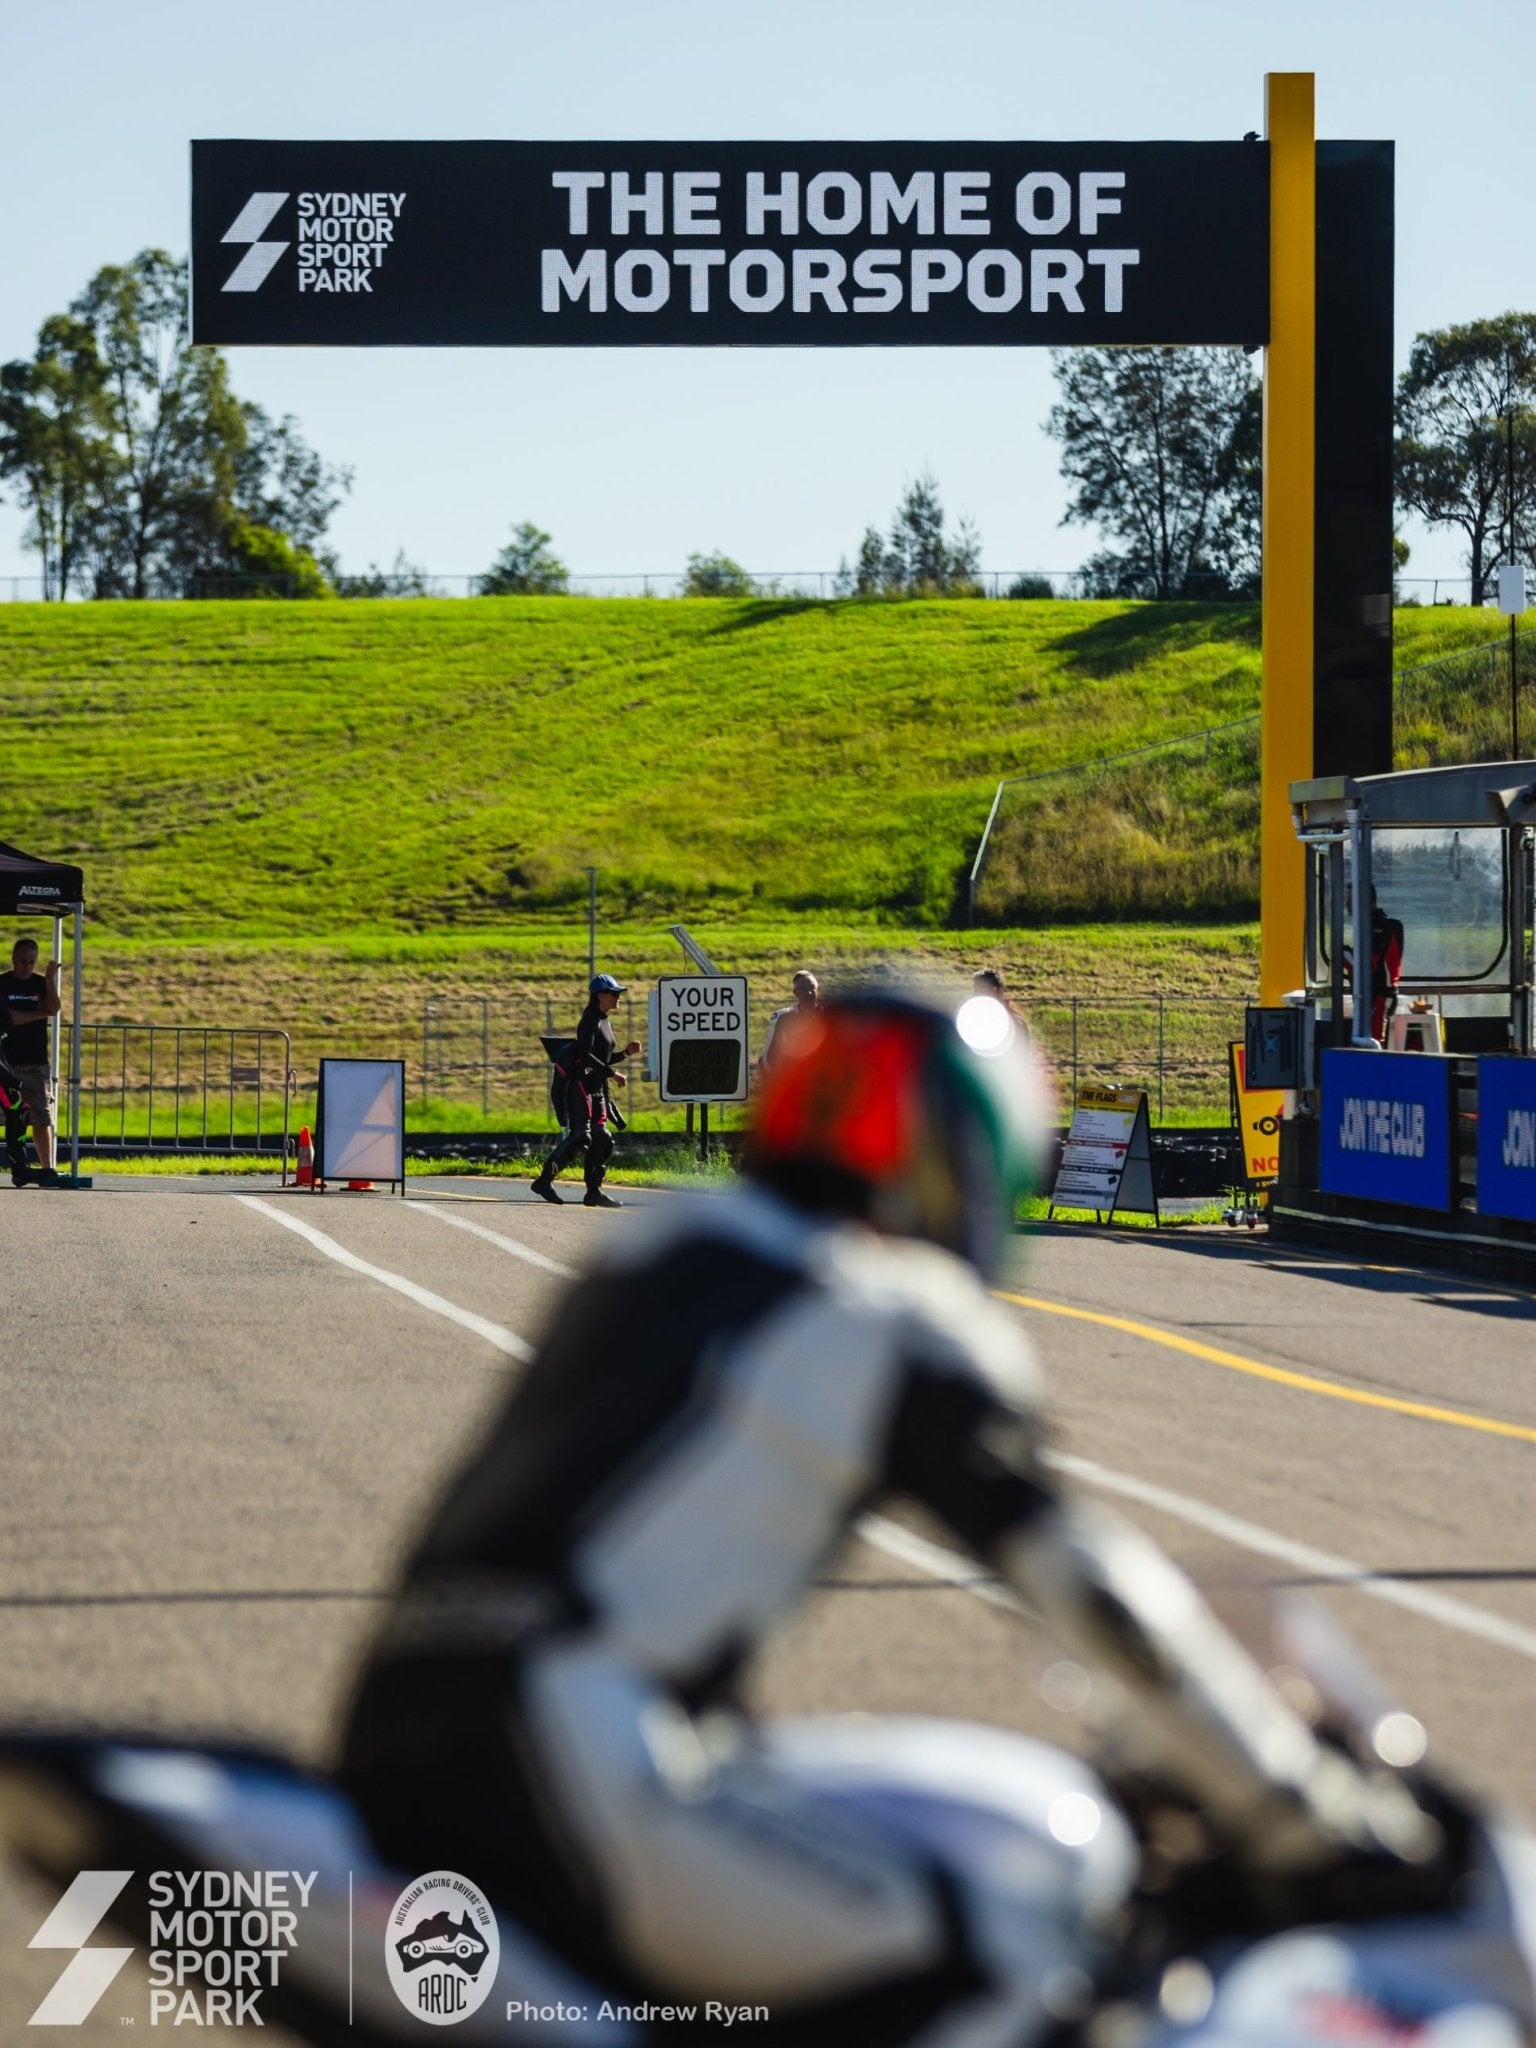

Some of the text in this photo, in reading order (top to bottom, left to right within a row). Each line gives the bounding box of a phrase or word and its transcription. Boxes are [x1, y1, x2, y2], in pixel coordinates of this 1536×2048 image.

[296, 192, 407, 218] SYDNEY
[552, 171, 1126, 235] THE HOME OF
[297, 218, 394, 242] MOTOR
[296, 243, 388, 268] SPORT
[298, 268, 374, 293] PARK
[541, 249, 1140, 313] MOTORSPORT
[18, 885, 61, 896] ALTEGRA
[671, 987, 735, 1007] YOUR
[667, 1012, 741, 1032] SPEED
[1082, 1091, 1094, 1102] THE
[1096, 1092, 1118, 1104] FLAGS
[1366, 1100, 1391, 1154] THE
[1391, 1101, 1425, 1158] CLUB
